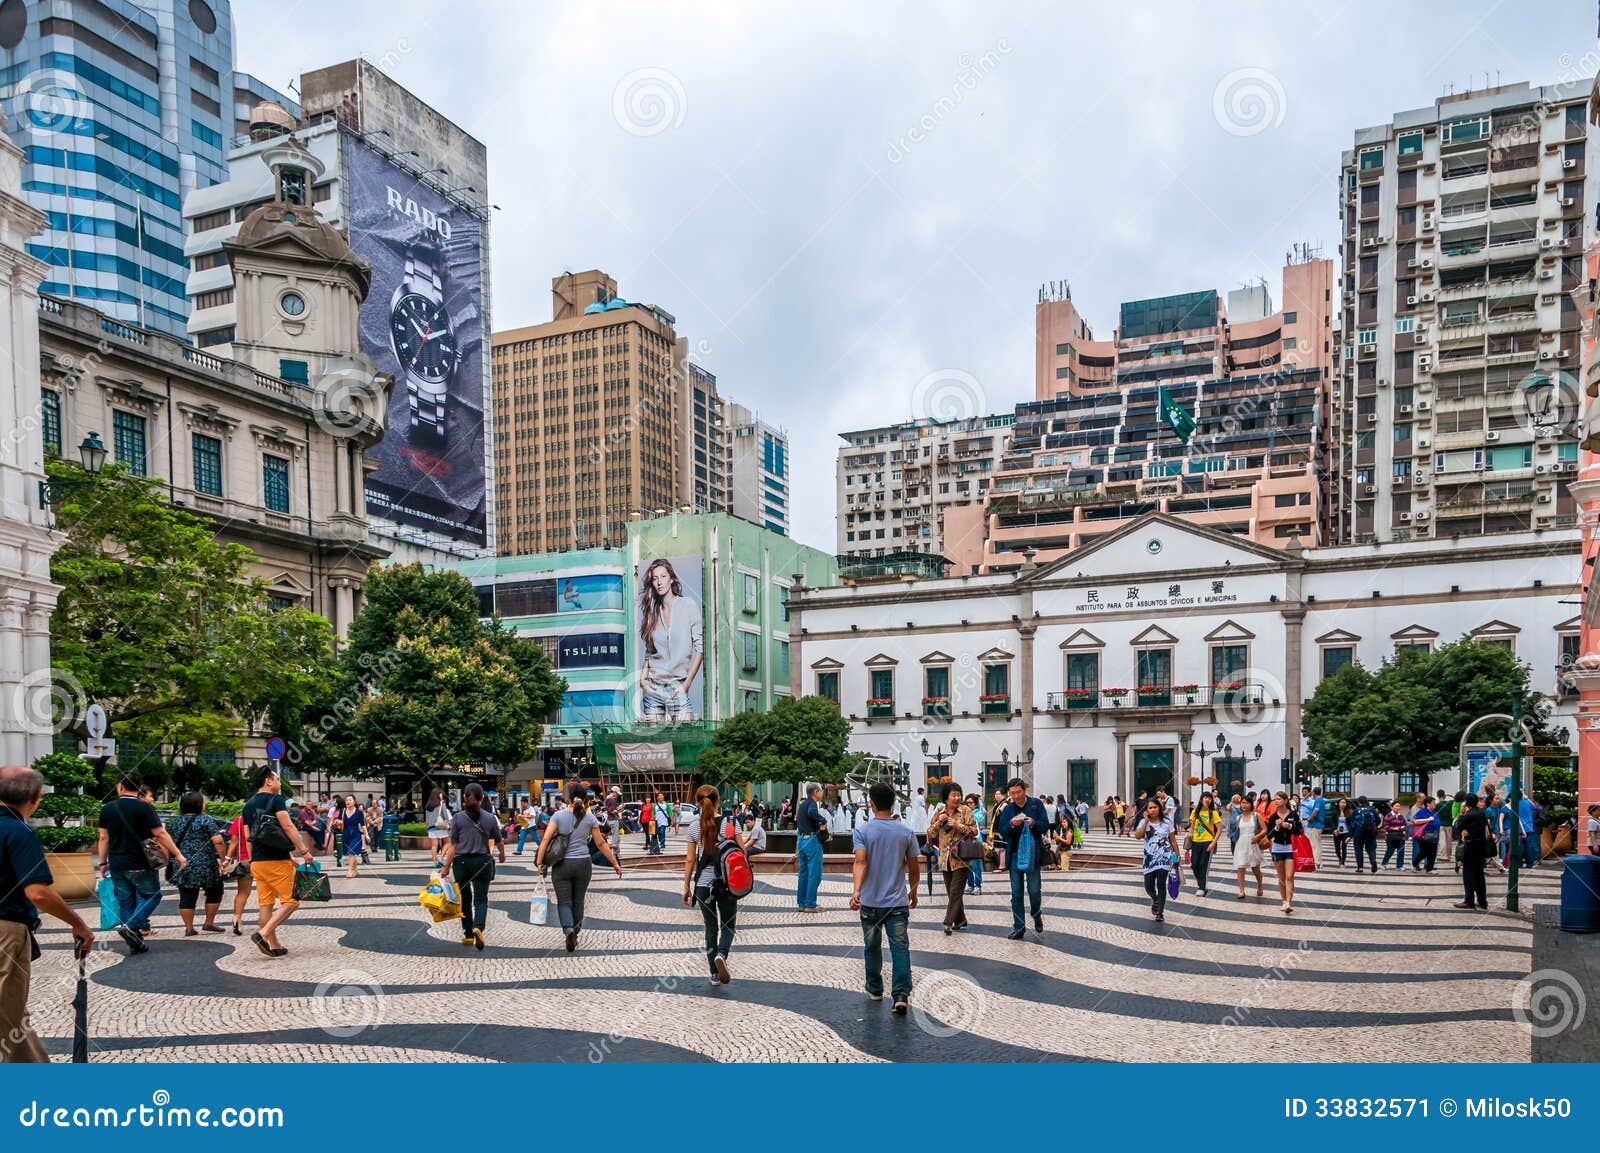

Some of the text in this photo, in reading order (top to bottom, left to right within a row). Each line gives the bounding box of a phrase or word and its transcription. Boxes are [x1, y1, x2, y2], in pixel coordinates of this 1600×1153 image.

[386, 185, 452, 240] RADO
[1087, 581, 1224, 603] 民政總署
[1075, 603, 1104, 611] INSTITUTO
[1137, 599, 1168, 607] ASSUNTOS
[1205, 595, 1237, 603] MUNICIPAIS
[564, 648, 587, 656] TSL
[571, 757, 595, 765] TSL
